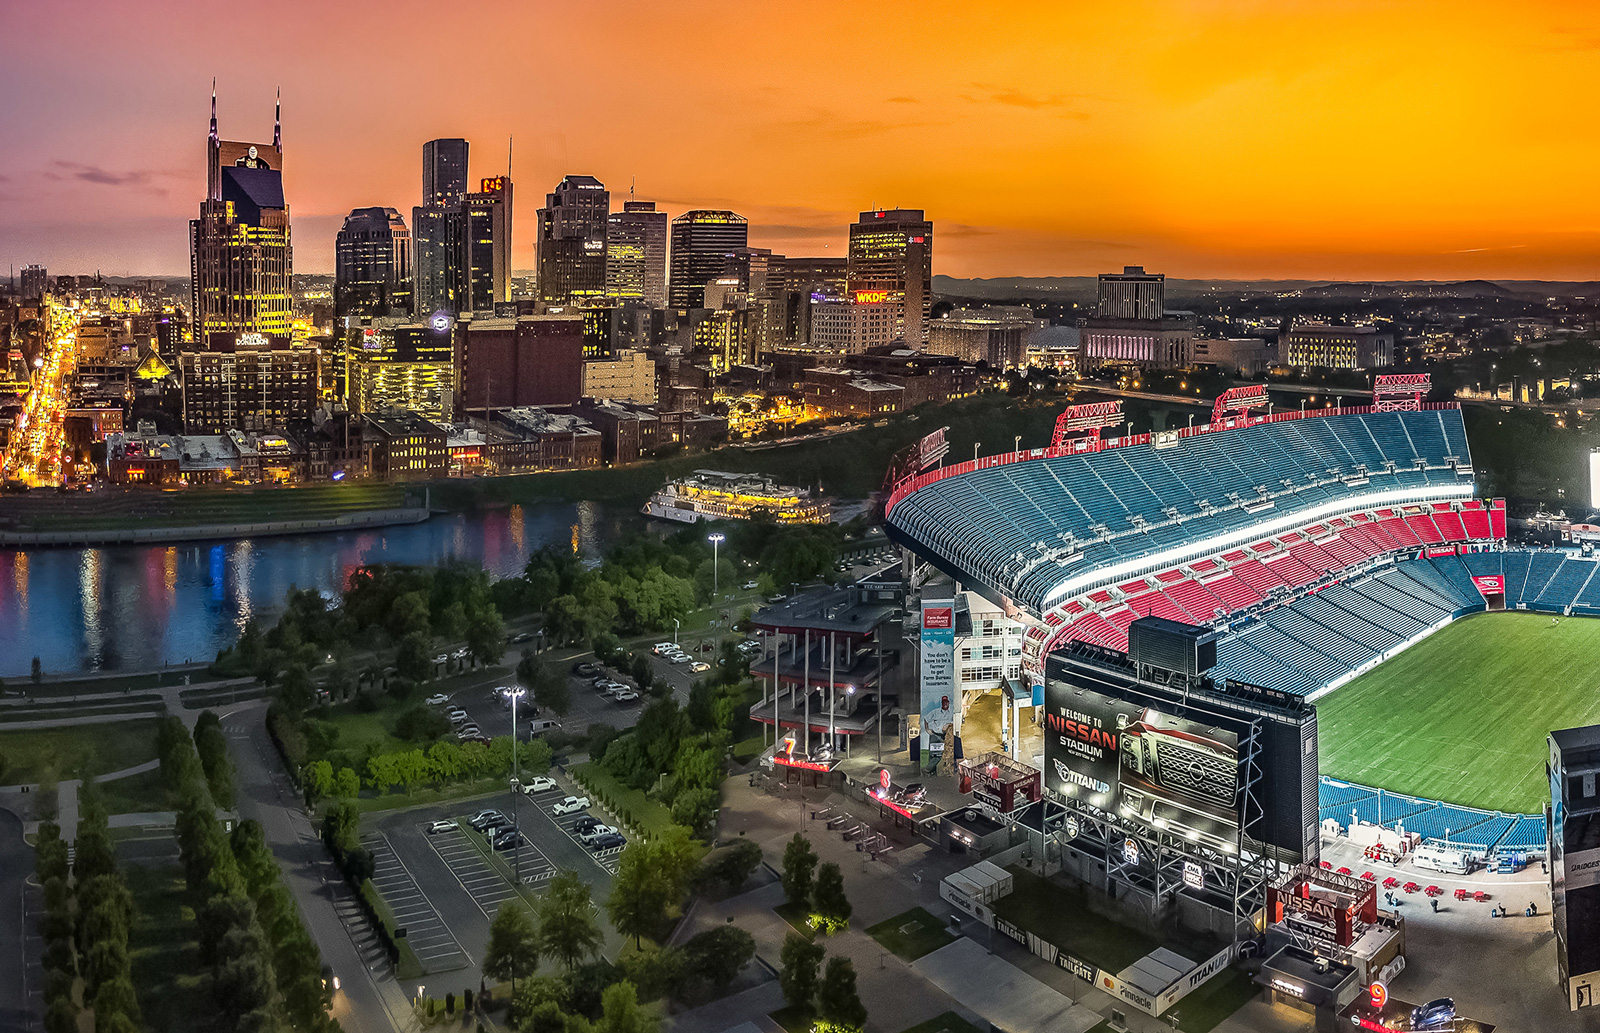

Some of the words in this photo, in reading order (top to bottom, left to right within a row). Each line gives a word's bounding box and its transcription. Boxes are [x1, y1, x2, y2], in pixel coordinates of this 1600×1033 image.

[856, 291, 888, 303] WKDF
[1060, 706, 1092, 726] WELCOME
[1093, 716, 1103, 729] TO
[1047, 713, 1117, 752] NISSAN
[784, 737, 797, 756] 7
[1059, 735, 1103, 759] STADIUM
[880, 768, 891, 788] 8
[963, 767, 1001, 792] NISSAN
[1013, 776, 1035, 790] NISSAN
[1276, 890, 1336, 920] NISSAN
[997, 920, 1026, 946] TAILGATE
[1059, 956, 1093, 982] TAILGATE
[1120, 984, 1152, 1010] Pinnacle
[1369, 981, 1389, 1008] 9
